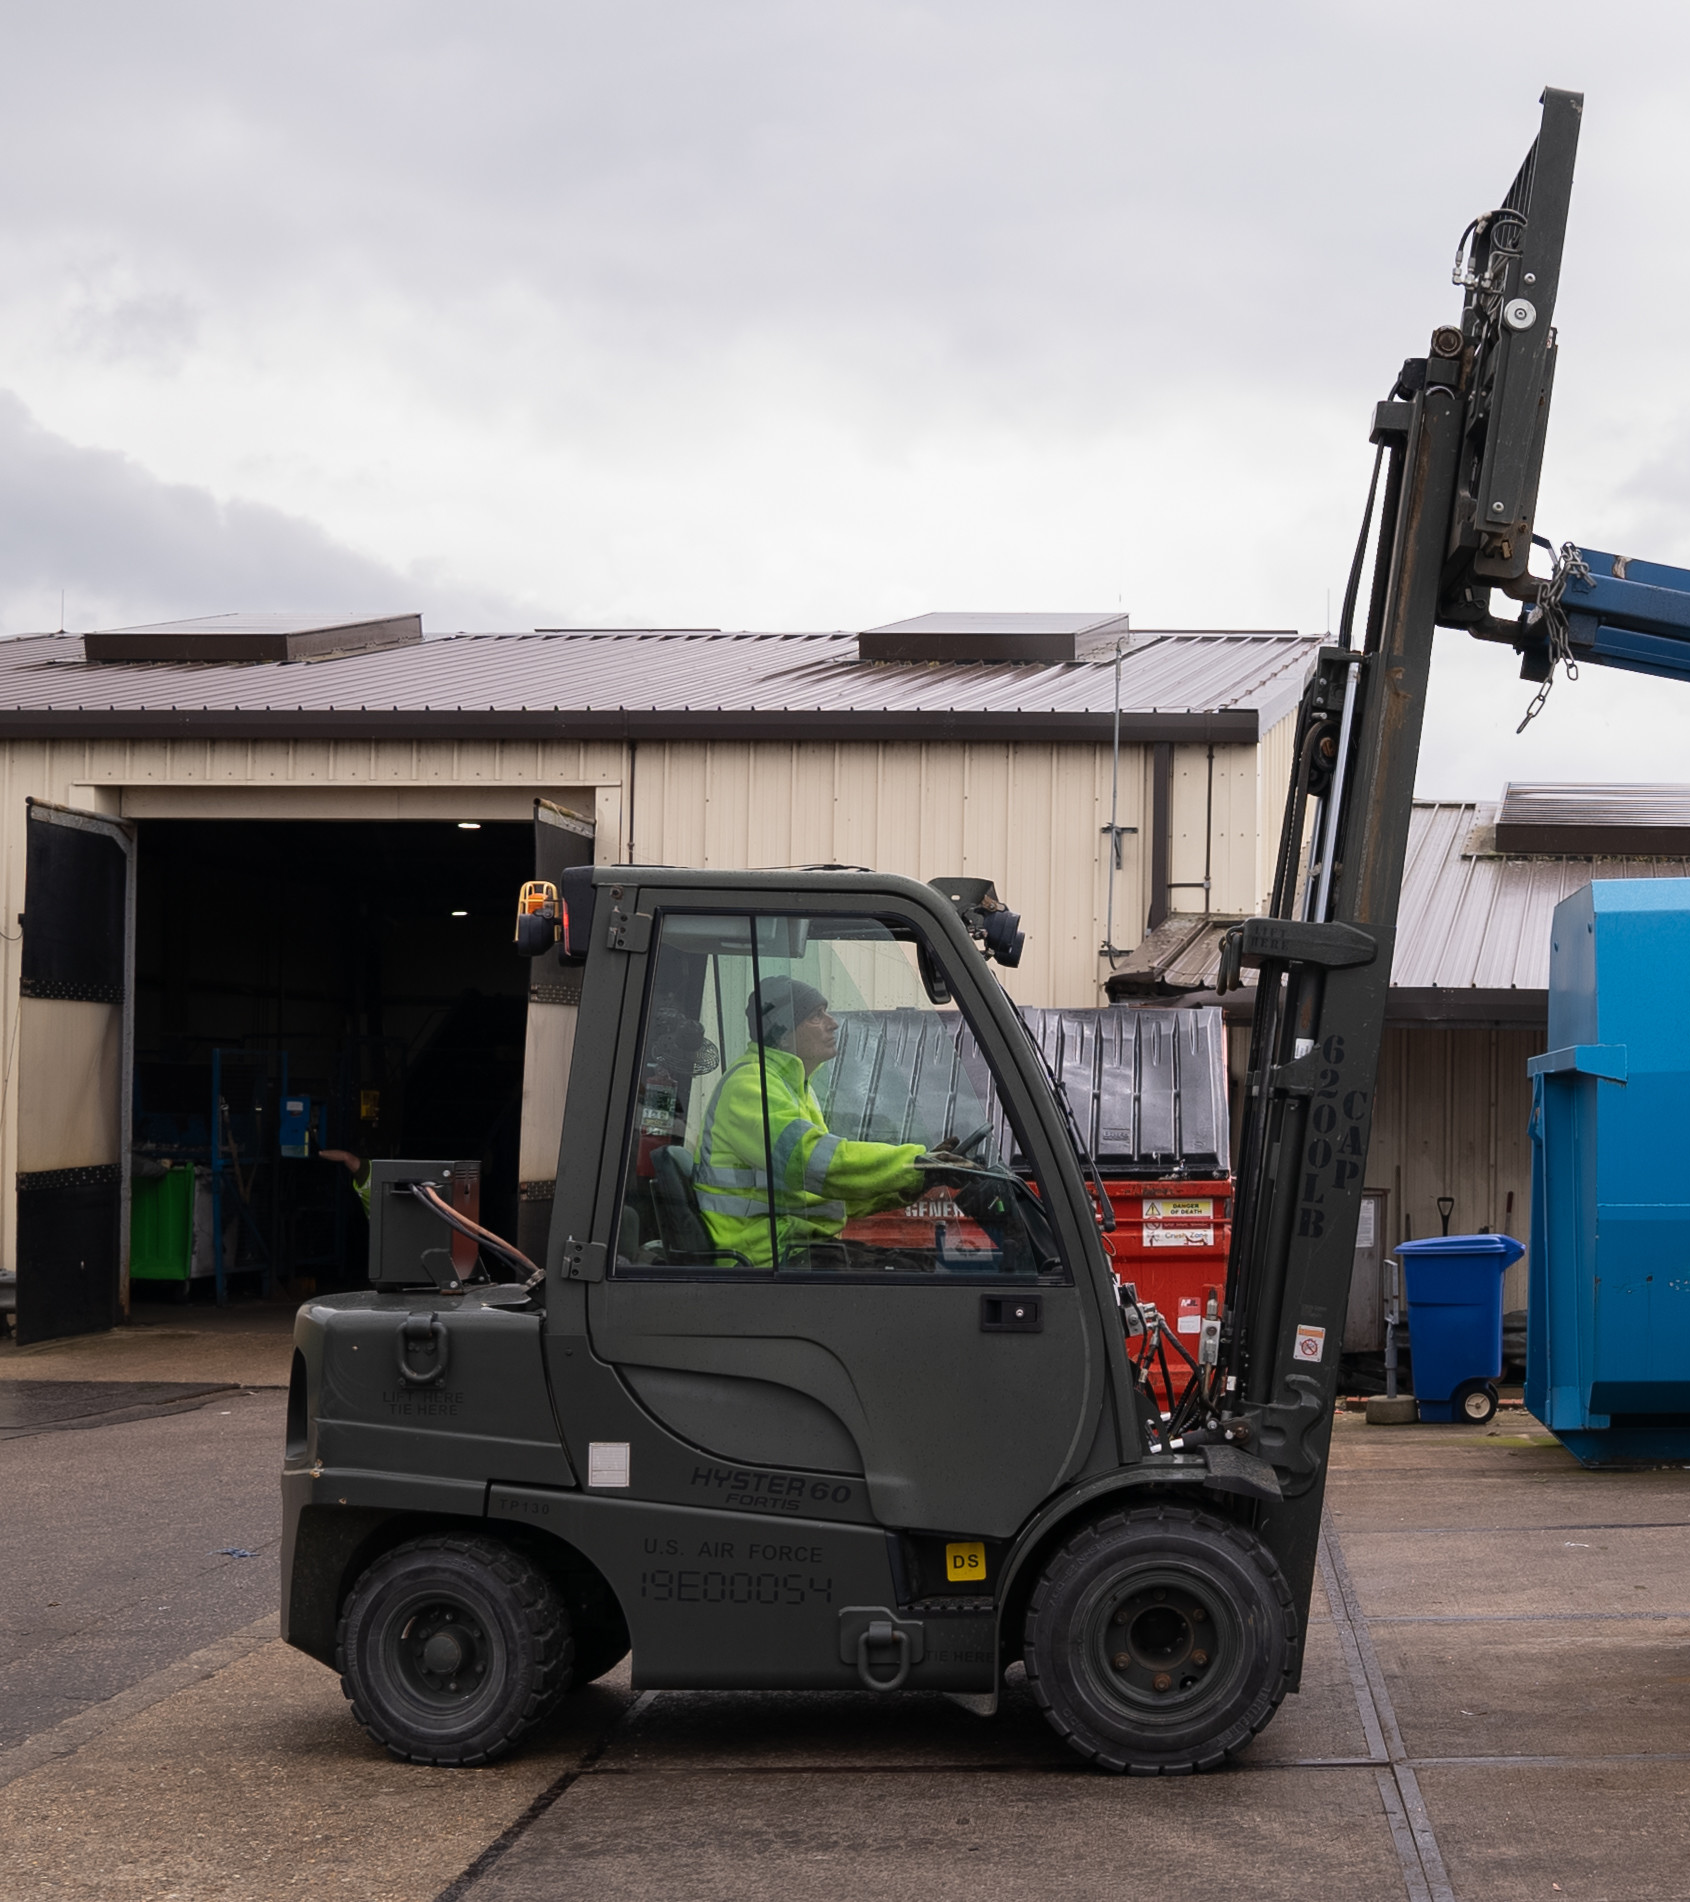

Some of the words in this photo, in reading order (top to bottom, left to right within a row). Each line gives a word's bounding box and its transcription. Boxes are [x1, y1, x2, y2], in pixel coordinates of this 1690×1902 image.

[1331, 1090, 1368, 1190] CAP
[383, 1391, 415, 1403] LIFT
[423, 1391, 465, 1404] HERE
[389, 1403, 412, 1415] TIE
[417, 1404, 458, 1416] HERE
[690, 1466, 807, 1497] HYSTER
[809, 1481, 852, 1504] 60
[725, 1492, 801, 1511] FORTIS
[643, 1537, 684, 1556] U.S.
[697, 1541, 735, 1559] AIR
[748, 1543, 823, 1563] FORCE
[953, 1553, 979, 1569] DS
[640, 1569, 833, 1605] 19E00054
[927, 1649, 948, 1662] TIE
[953, 1650, 995, 1664] HERE
